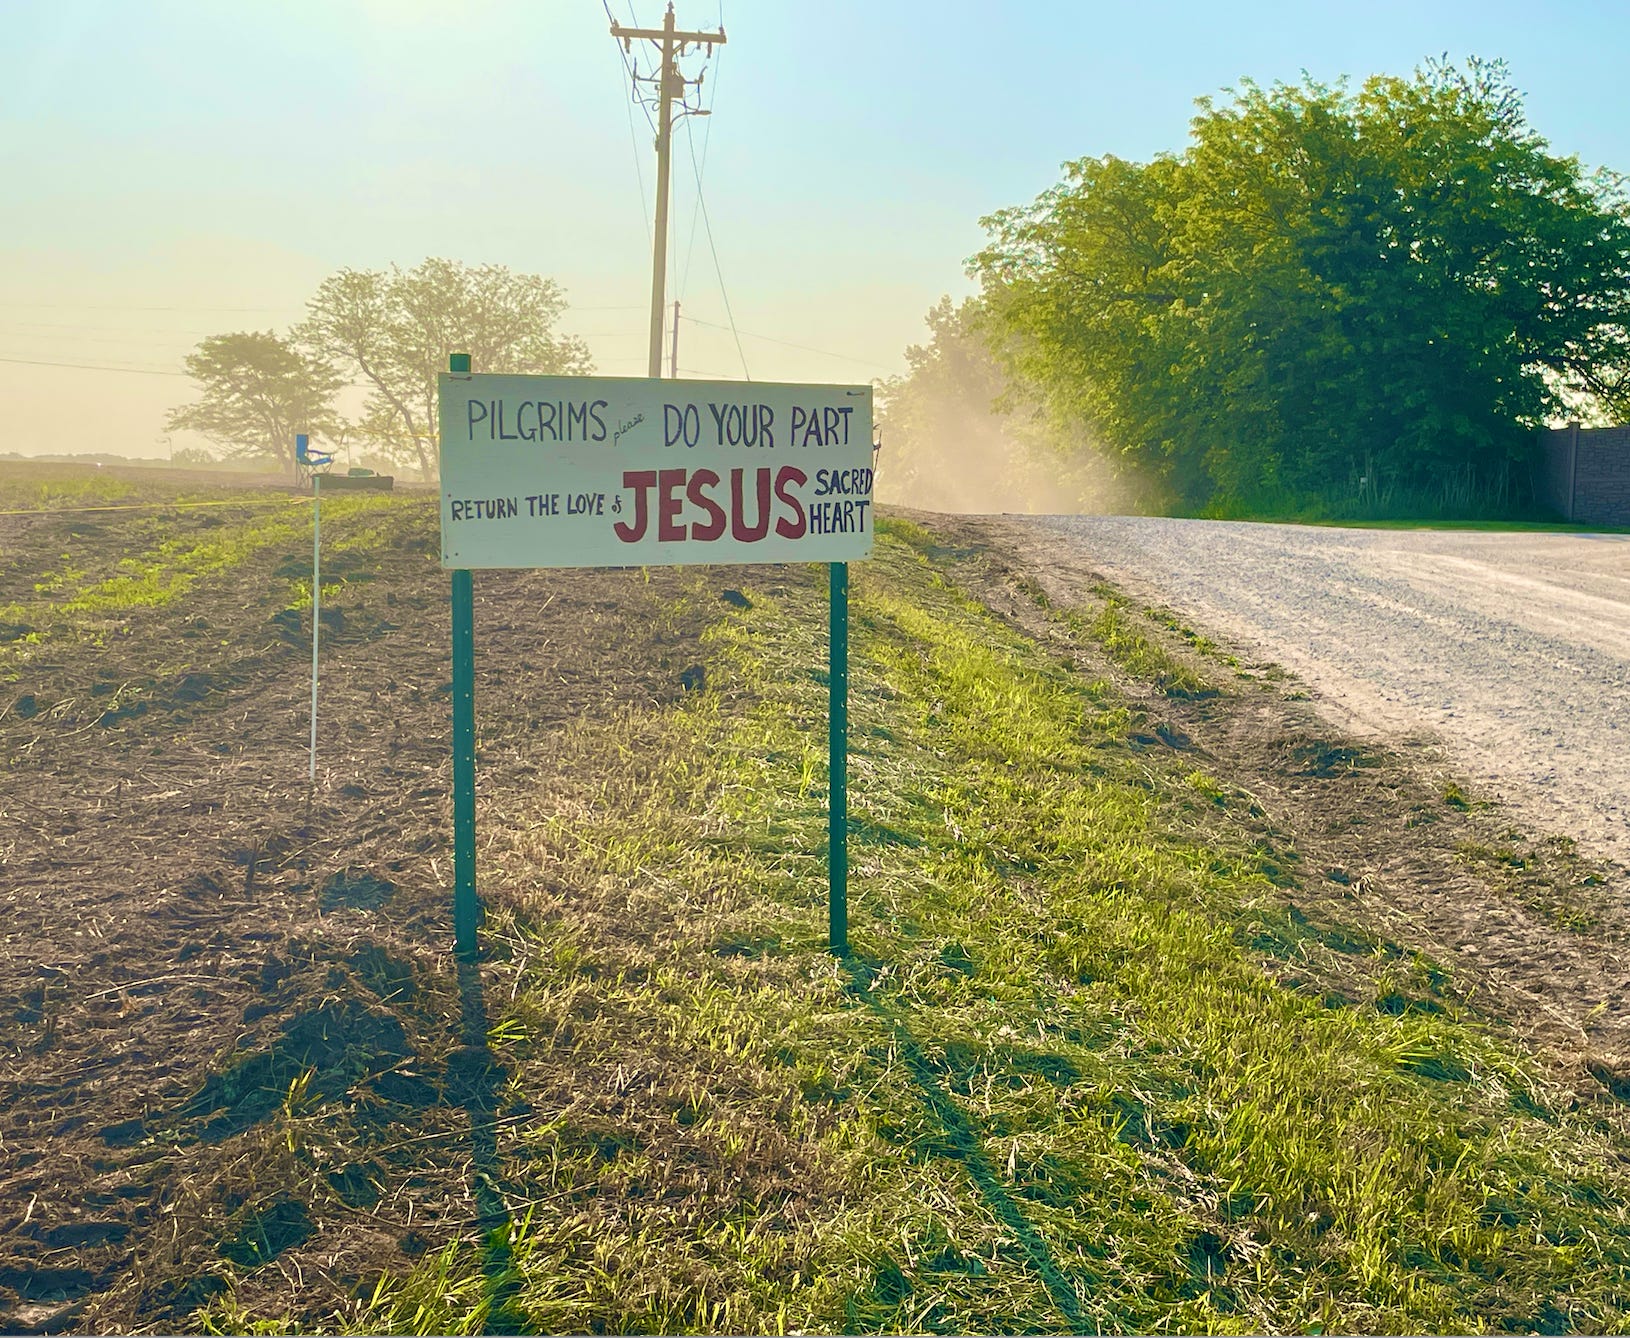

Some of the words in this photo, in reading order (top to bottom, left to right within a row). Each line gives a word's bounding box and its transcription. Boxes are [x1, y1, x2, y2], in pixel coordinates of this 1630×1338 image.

[468, 400, 608, 442] PILGRIMS
[613, 413, 645, 446] please
[663, 403, 700, 448] DO
[708, 403, 774, 448] YOUR
[791, 406, 853, 447] PART
[814, 468, 873, 496] SACRED
[451, 497, 518, 521] RETURN
[525, 493, 559, 517] THE
[567, 492, 605, 516] LOVE
[611, 494, 622, 514] of
[613, 465, 808, 543] JESUS
[809, 500, 870, 535] HEART
